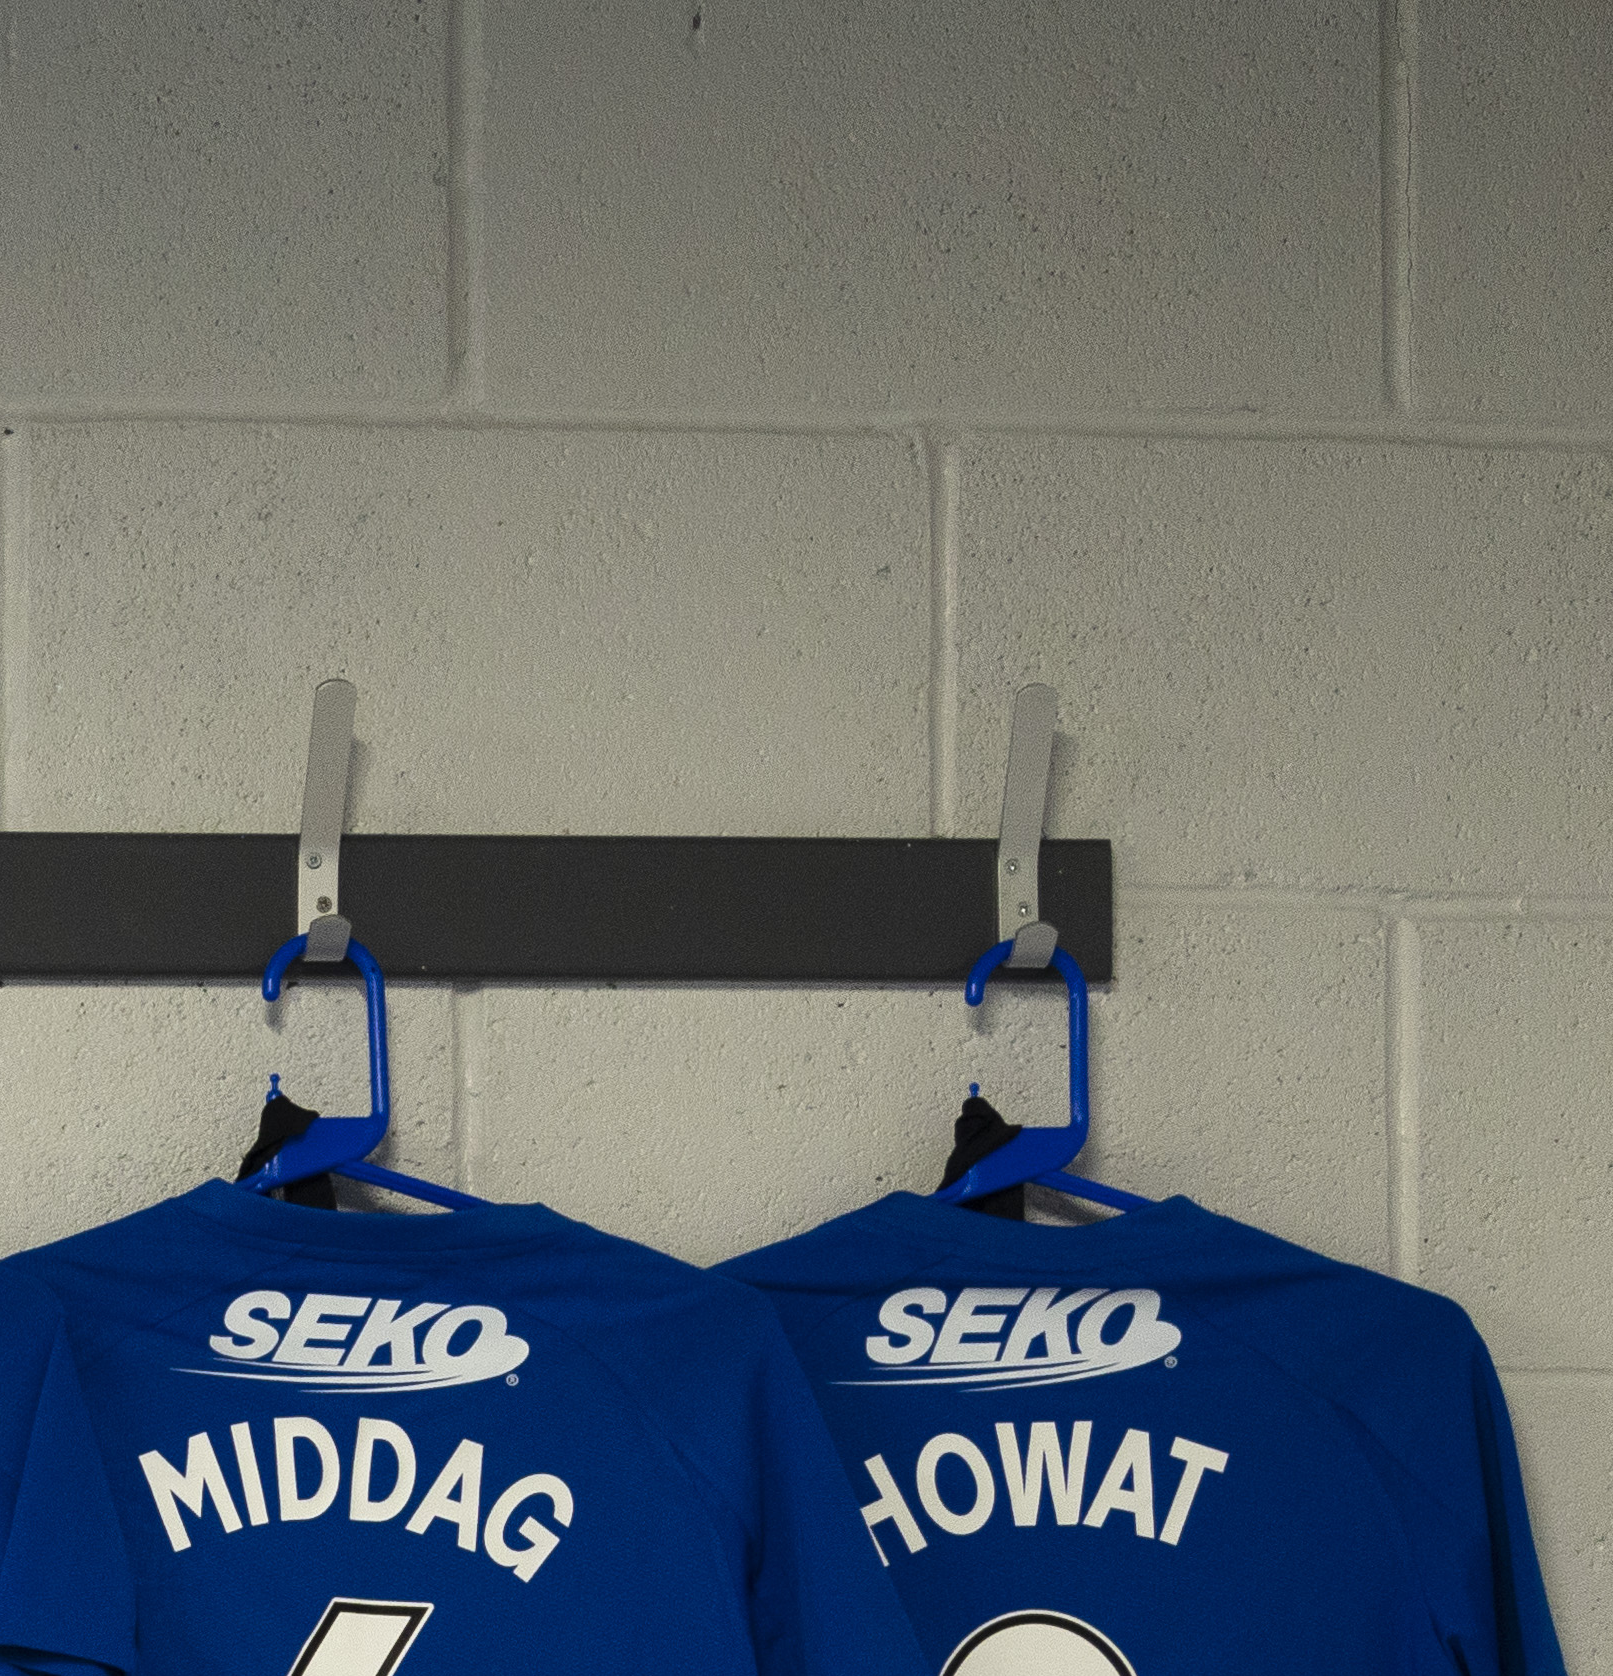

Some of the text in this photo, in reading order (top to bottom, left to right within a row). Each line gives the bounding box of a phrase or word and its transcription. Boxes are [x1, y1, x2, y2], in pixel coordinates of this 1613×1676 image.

[209, 1289, 508, 1371] SEKO
[865, 1287, 1162, 1366] SEKO
[137, 1416, 574, 1584] MIDDAG
